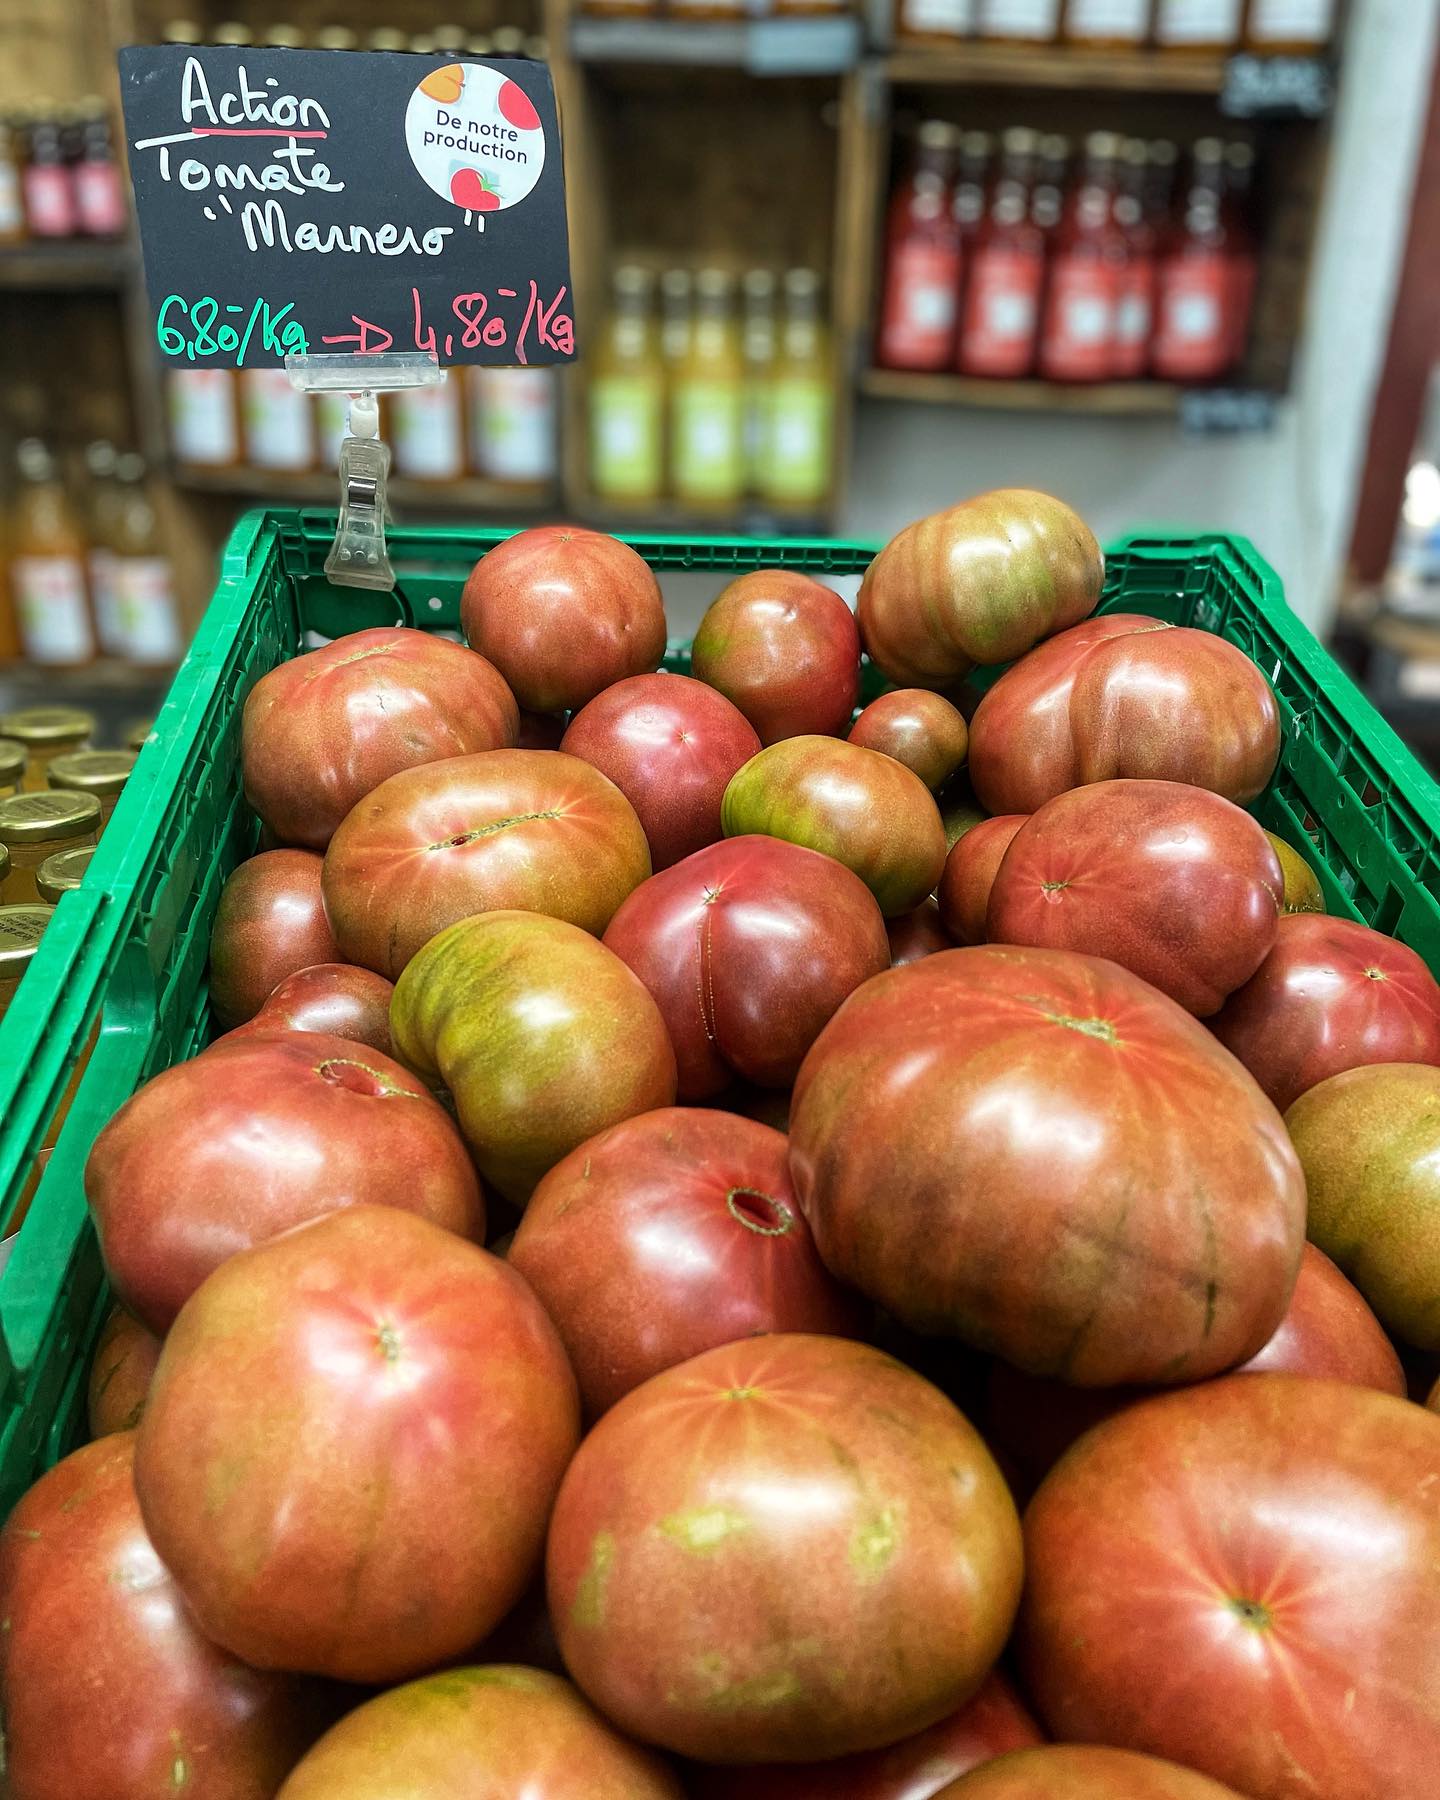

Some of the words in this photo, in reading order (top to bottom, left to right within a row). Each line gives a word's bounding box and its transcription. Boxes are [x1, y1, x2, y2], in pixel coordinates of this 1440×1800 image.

[182, 57, 331, 128] Action
[423, 130, 528, 165] production
[436, 109, 462, 129] De
[468, 120, 519, 142] notre
[135, 132, 345, 195] Tomate
